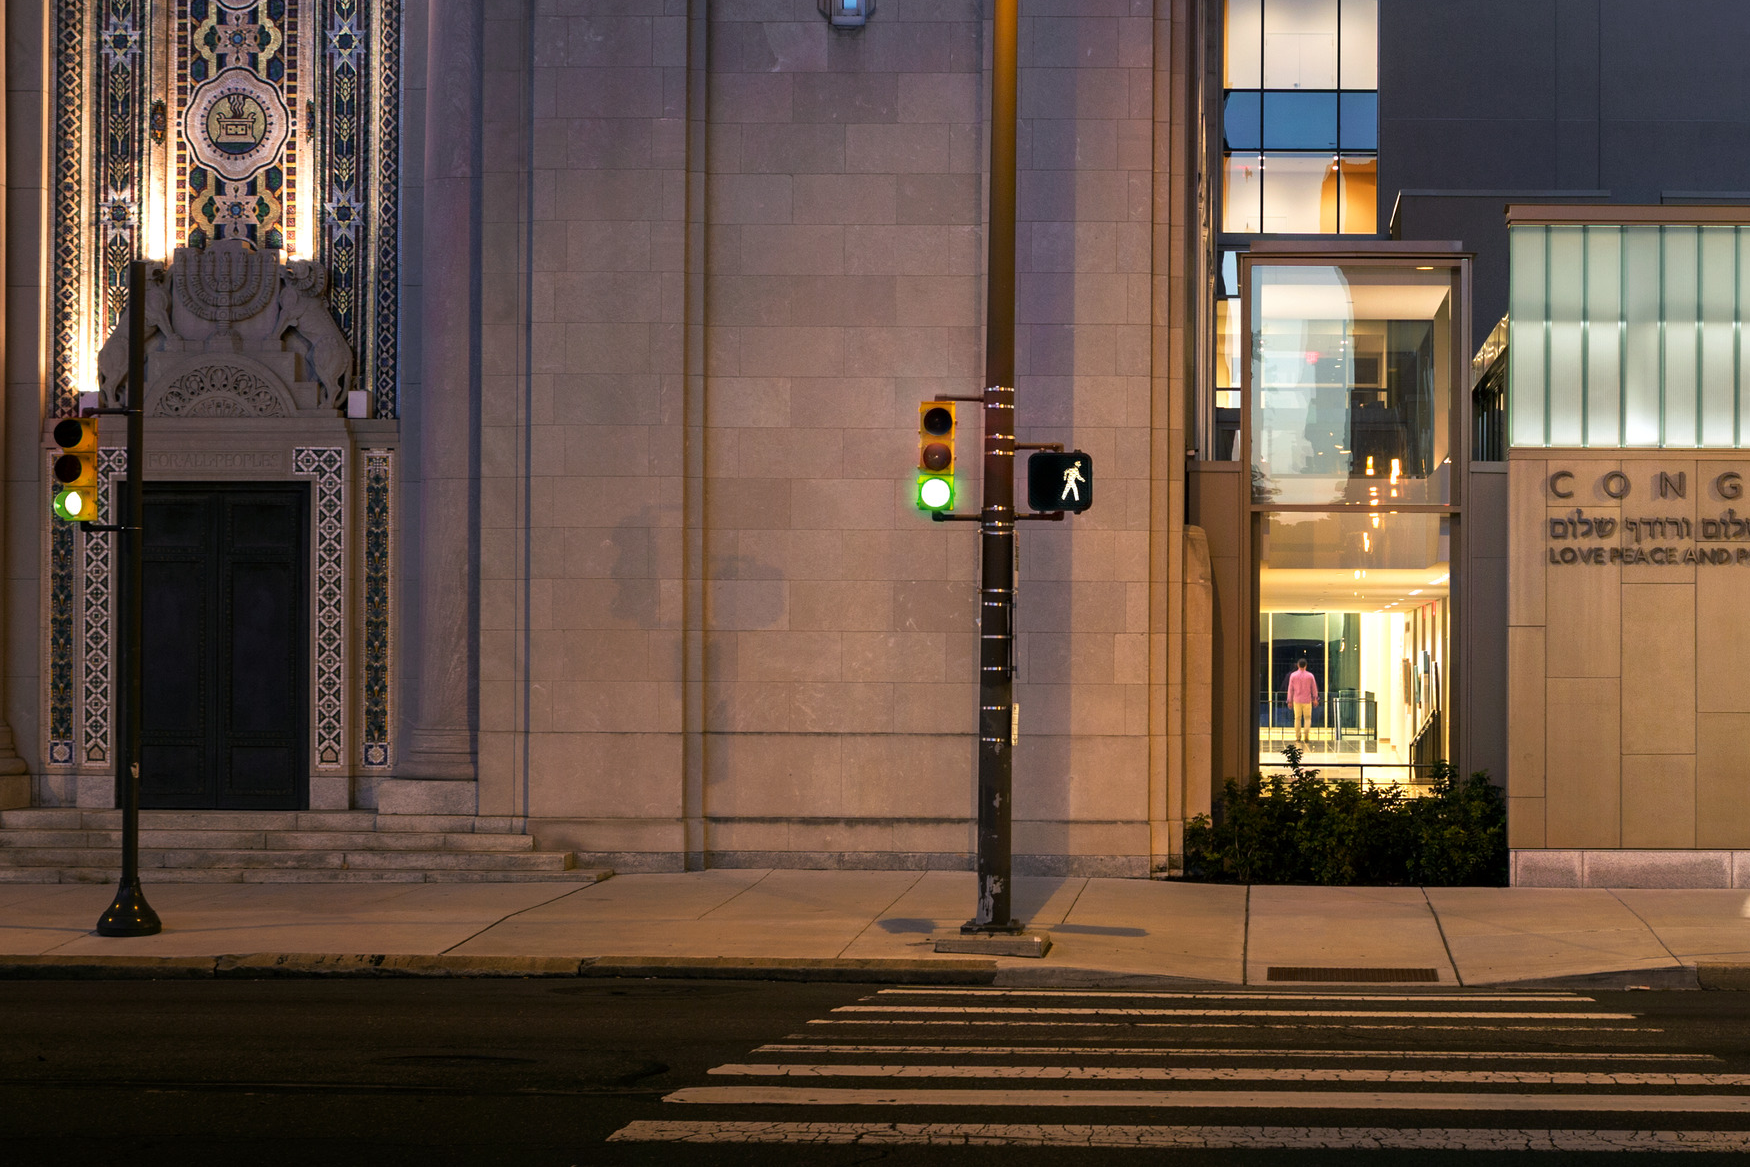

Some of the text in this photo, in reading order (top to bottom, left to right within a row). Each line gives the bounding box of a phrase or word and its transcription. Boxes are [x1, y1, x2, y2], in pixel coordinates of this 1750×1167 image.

[148, 453, 280, 468] FOR ALL PEOPLES
[1549, 508, 1618, 539] שלום
[1625, 516, 1693, 544] ורודף
[1549, 547, 1606, 564] LOVE
[1609, 547, 1678, 564] PEACE
[1682, 547, 1733, 565] AND
